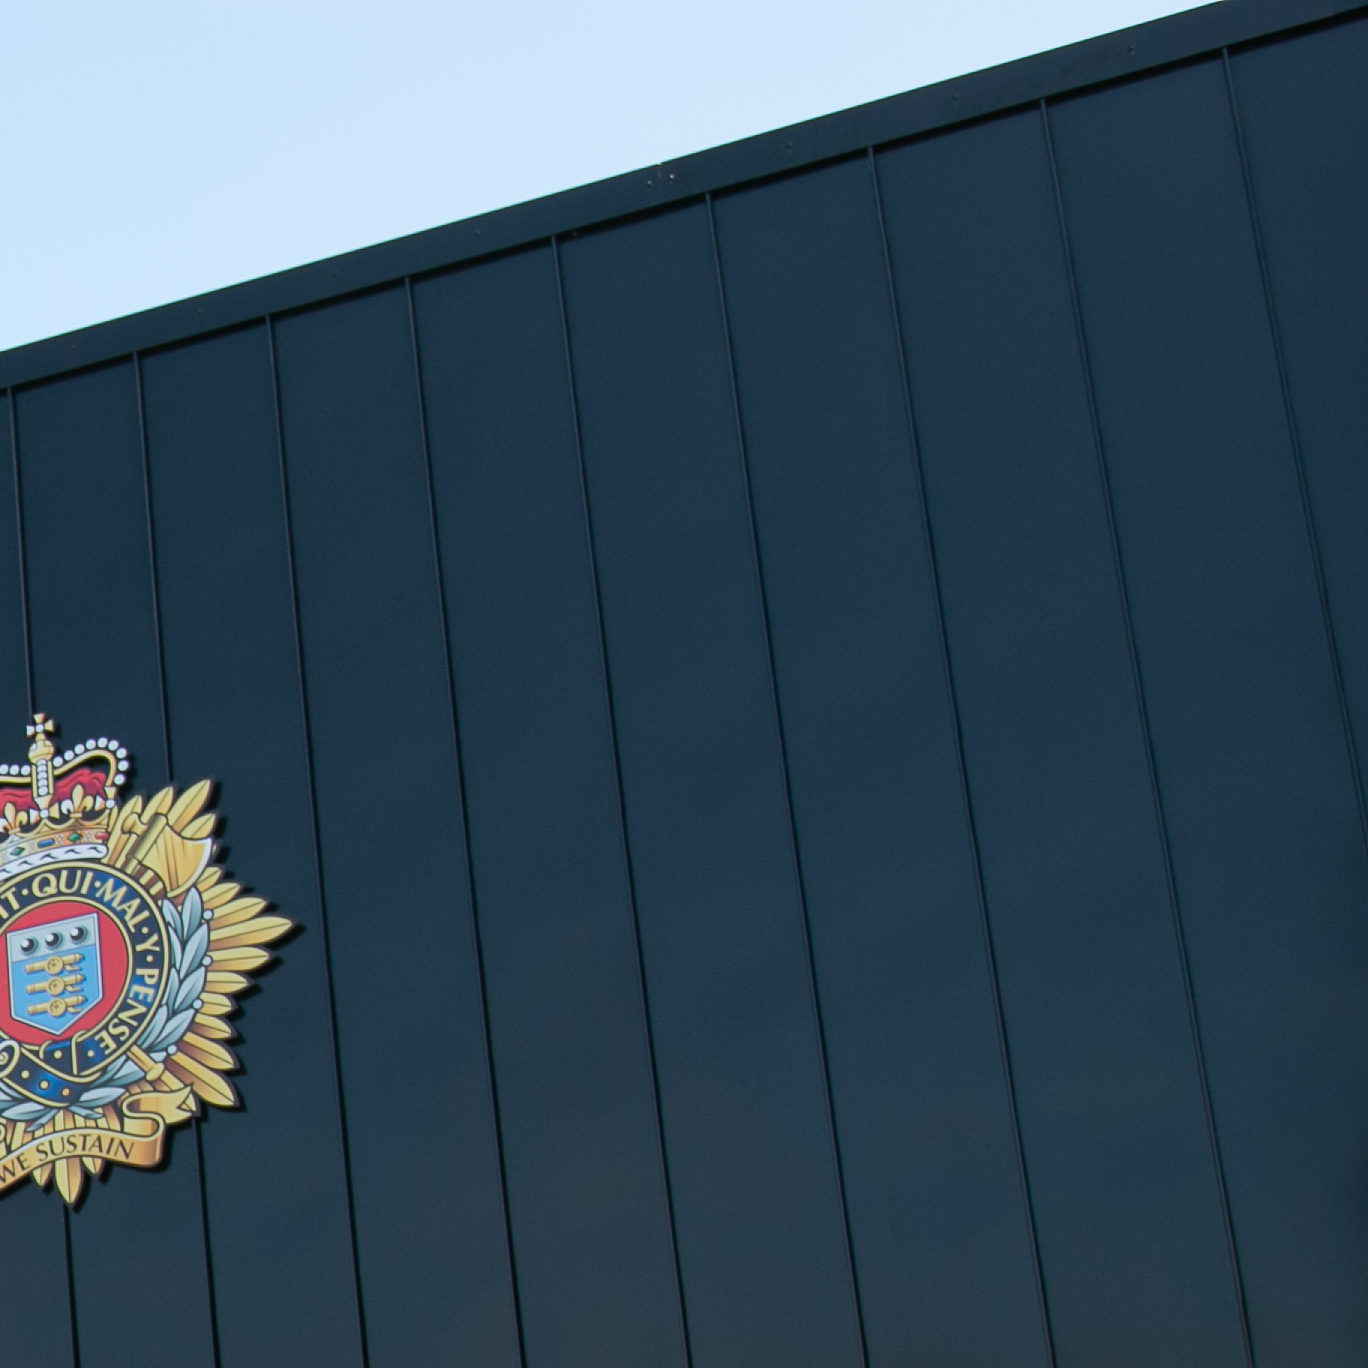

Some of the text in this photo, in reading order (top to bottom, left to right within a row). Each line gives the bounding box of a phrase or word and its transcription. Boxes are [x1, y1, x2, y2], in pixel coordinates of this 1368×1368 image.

[31, 869, 96, 899] QUI
[97, 880, 147, 934] MAL
[94, 965, 157, 1055] PENSE
[37, 1133, 136, 1164] SUSTAIN
